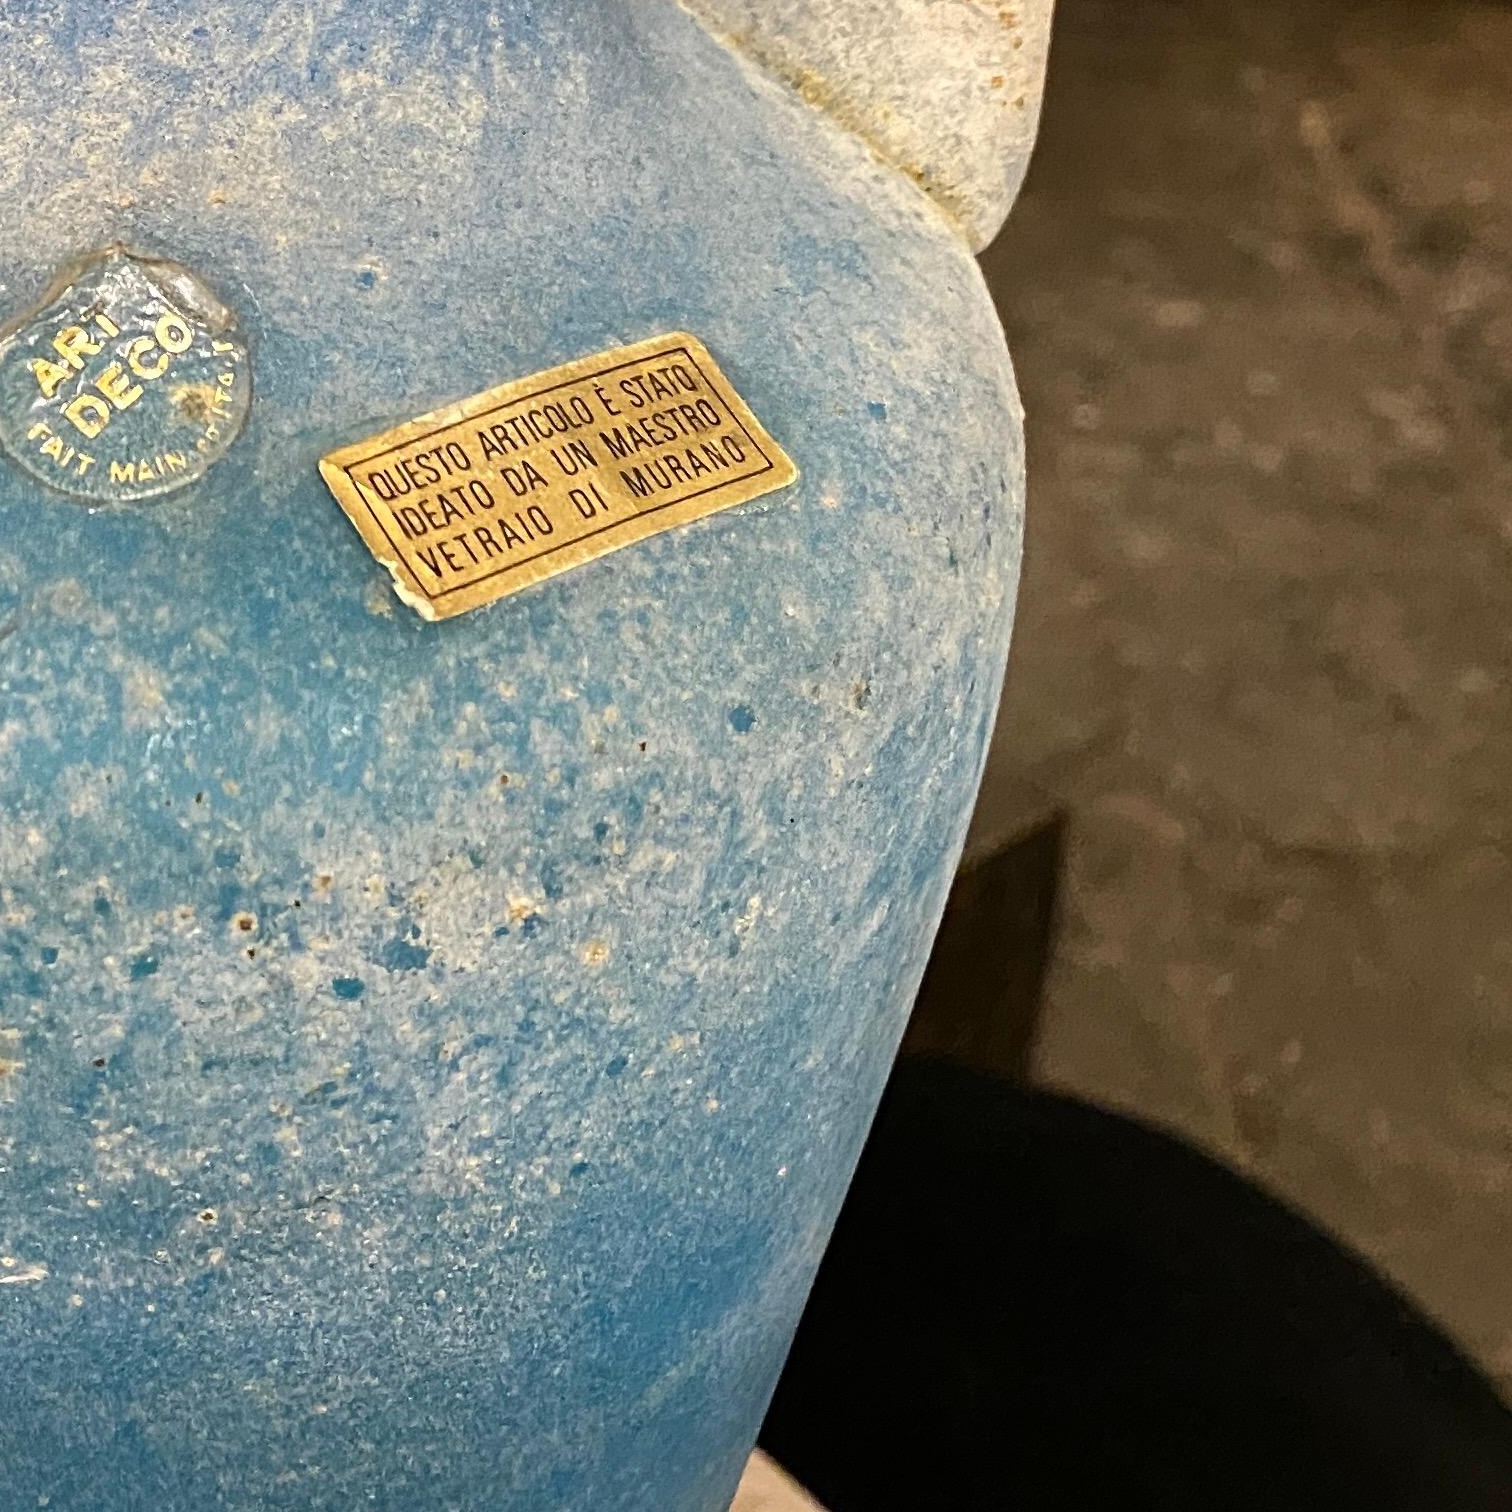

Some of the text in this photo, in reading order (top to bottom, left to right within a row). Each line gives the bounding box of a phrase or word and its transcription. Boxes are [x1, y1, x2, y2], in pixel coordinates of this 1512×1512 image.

[60, 308, 193, 439] DECO
[367, 441, 472, 502] QUESTO
[476, 395, 595, 462] ARTICOLO
[619, 363, 699, 409] STATO
[27, 422, 96, 476] FAIT
[109, 449, 187, 484] MAIN
[391, 397, 722, 541] IDEATO DA UN MAESTRO
[415, 434, 747, 579] VETRAIO DI MURANO
